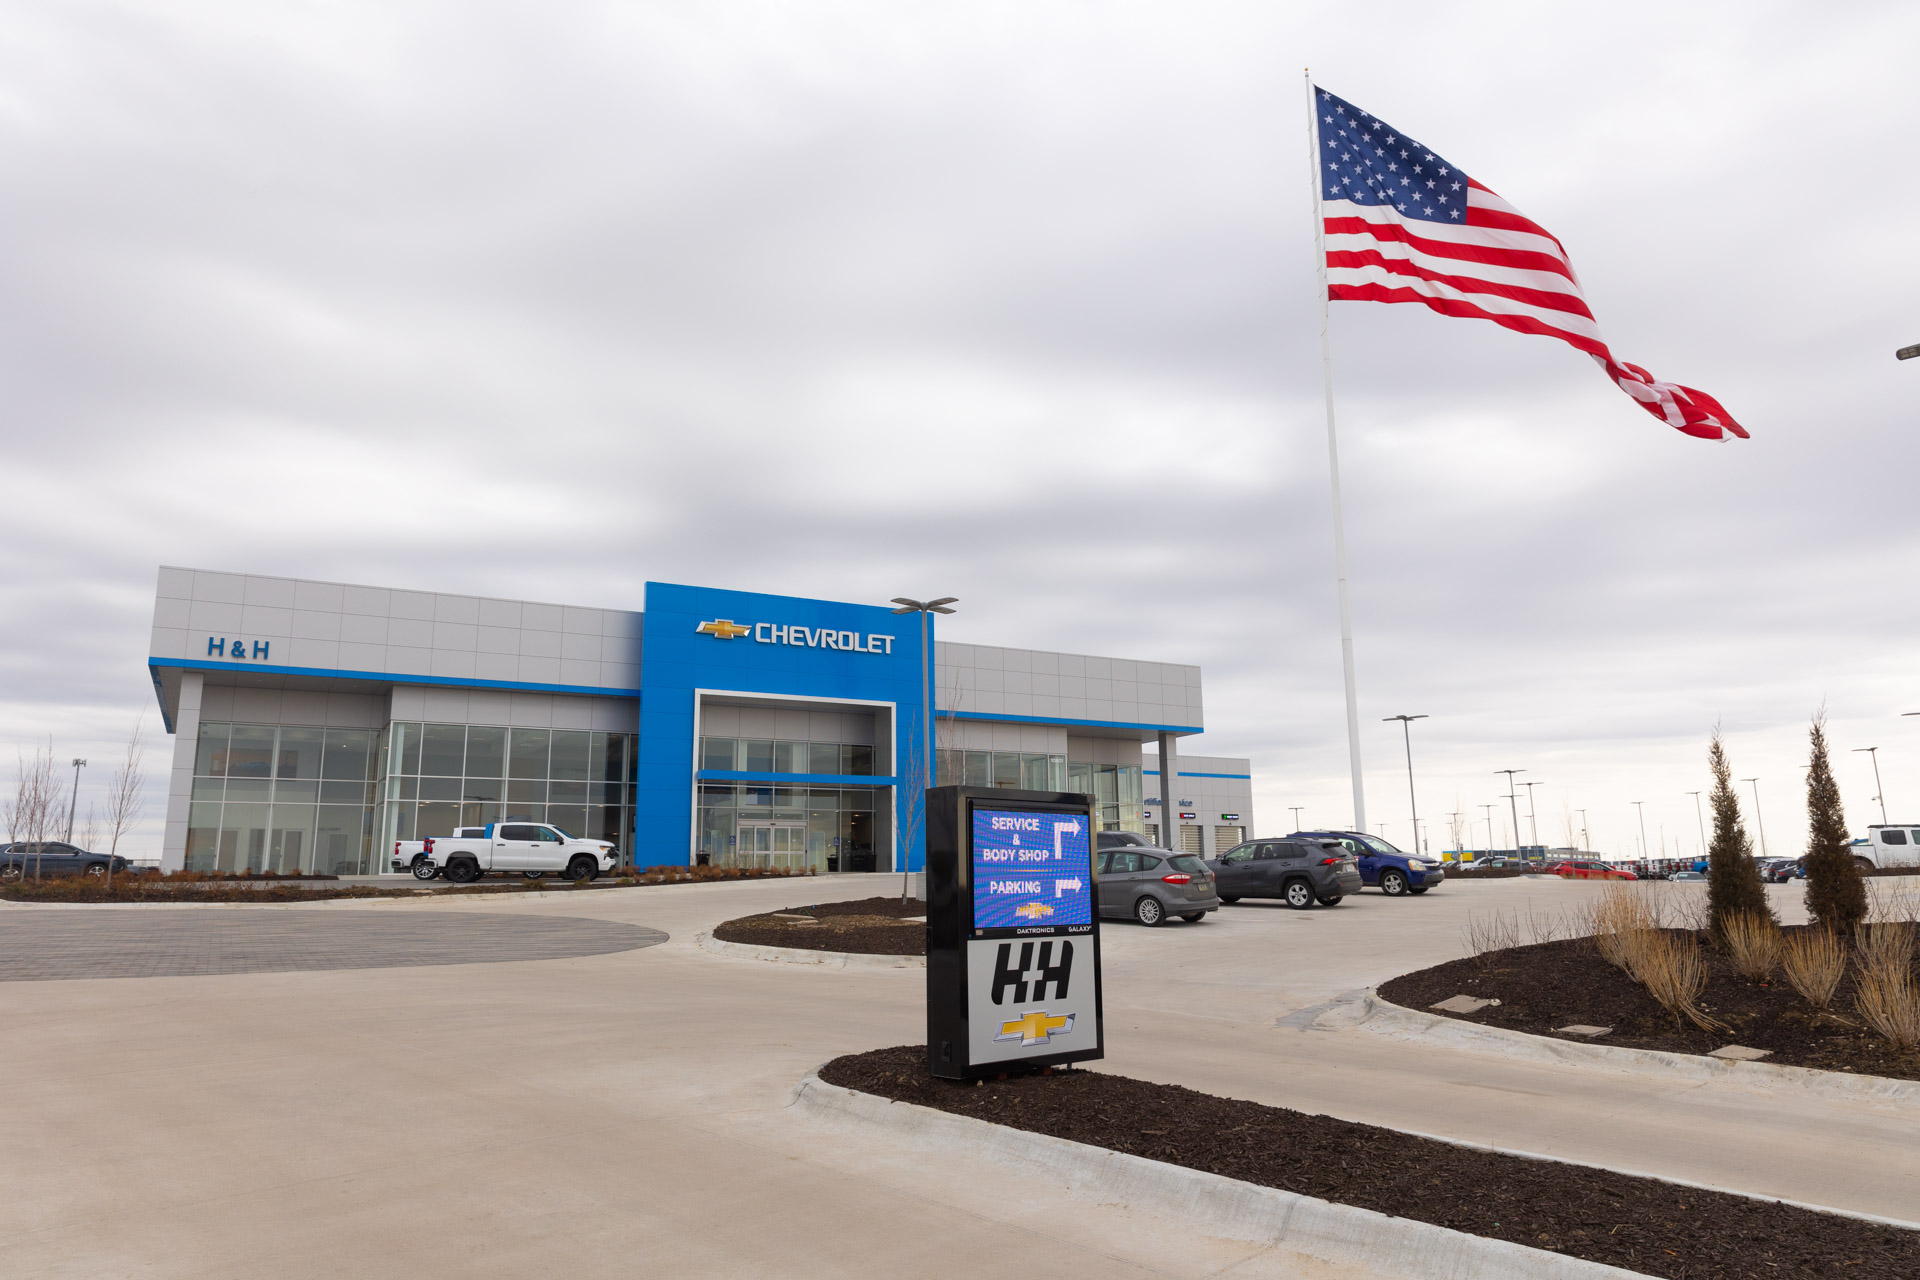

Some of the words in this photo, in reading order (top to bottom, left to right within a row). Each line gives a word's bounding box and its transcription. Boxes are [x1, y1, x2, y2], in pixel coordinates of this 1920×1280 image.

[755, 622, 895, 655] CHEVROLET
[991, 816, 1040, 831] SERVICE
[1012, 833, 1021, 846] &
[983, 848, 1016, 862] BODY
[1018, 849, 1050, 862] SHOP
[990, 880, 1041, 894] PARKING
